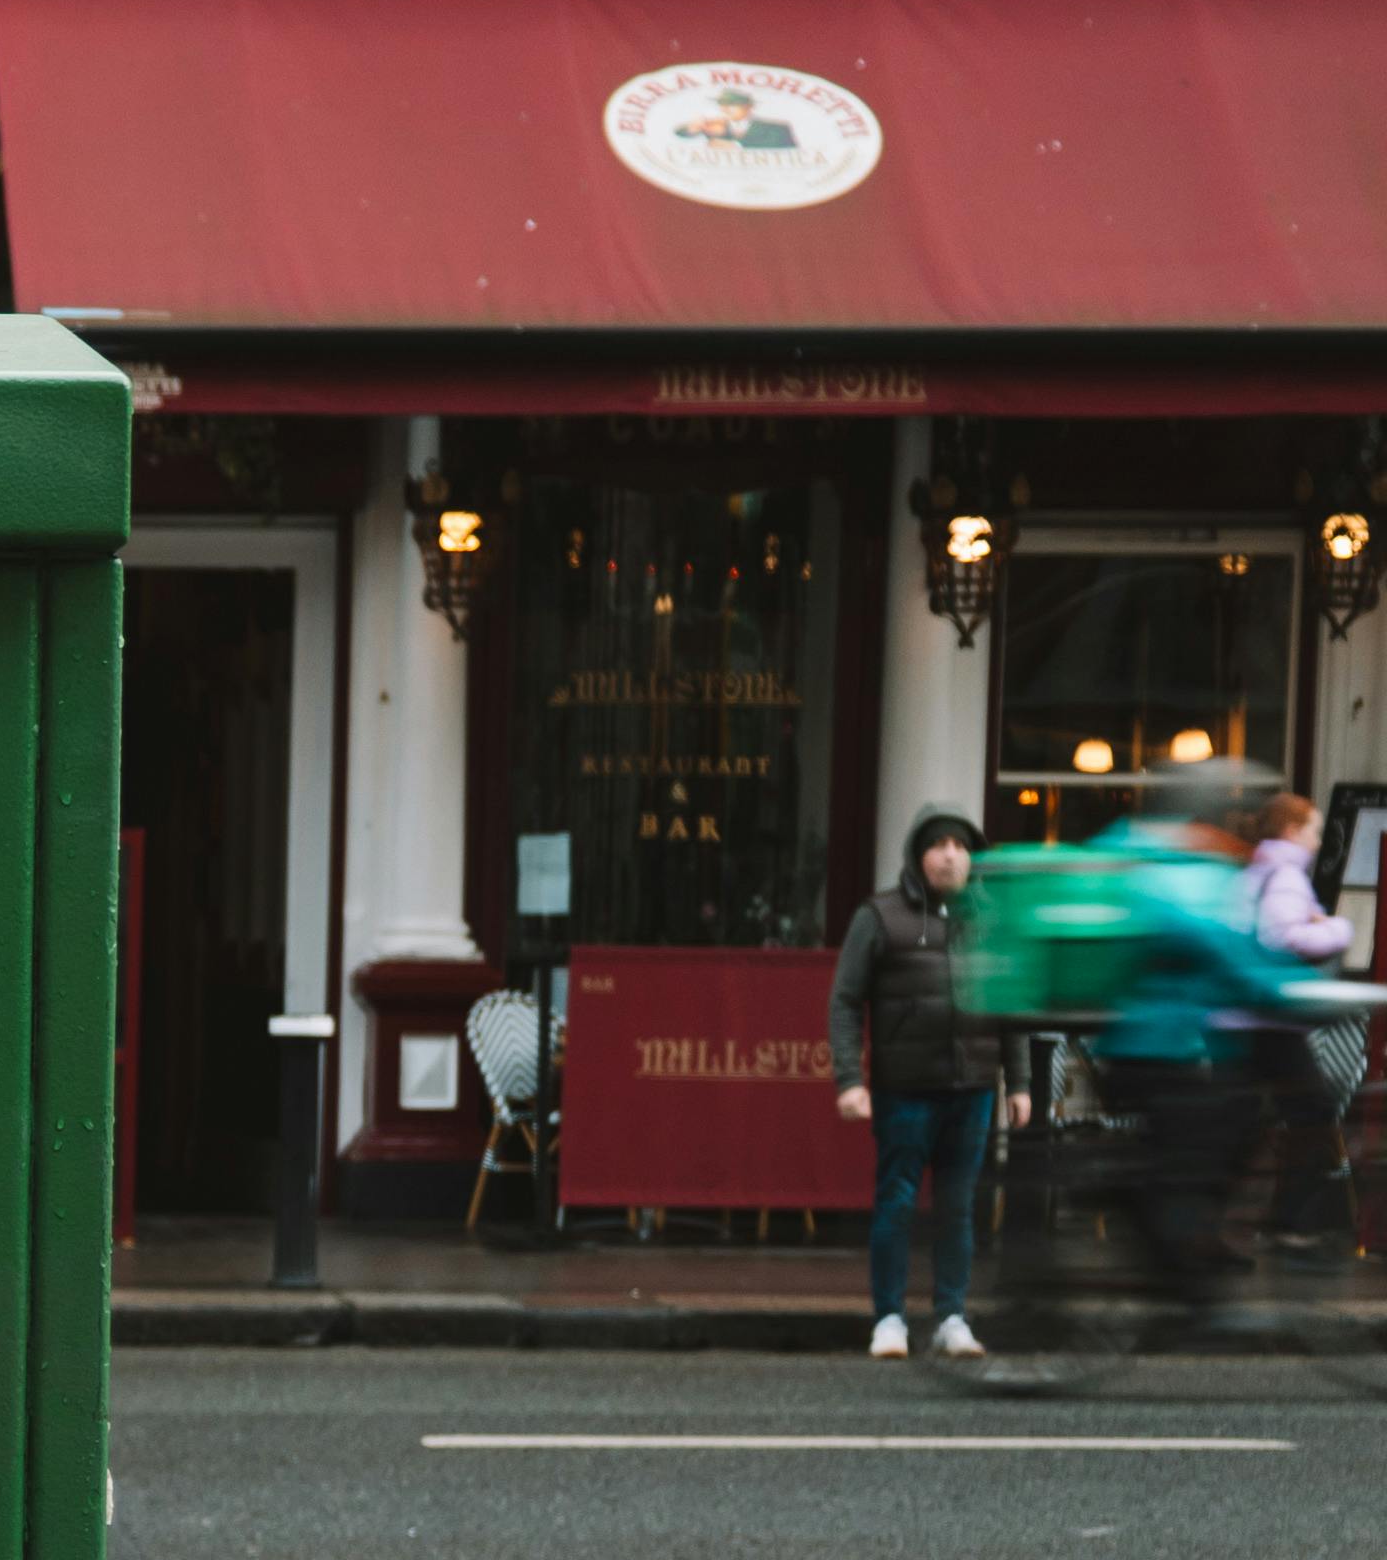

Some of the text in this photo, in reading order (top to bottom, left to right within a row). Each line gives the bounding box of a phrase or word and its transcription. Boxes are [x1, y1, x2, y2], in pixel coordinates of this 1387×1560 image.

[617, 69, 872, 138] BIRRA MORETTI
[581, 754, 771, 775] RESTAURANT
[640, 813, 721, 841] BAR
[635, 1038, 833, 1076] MILLSTO
